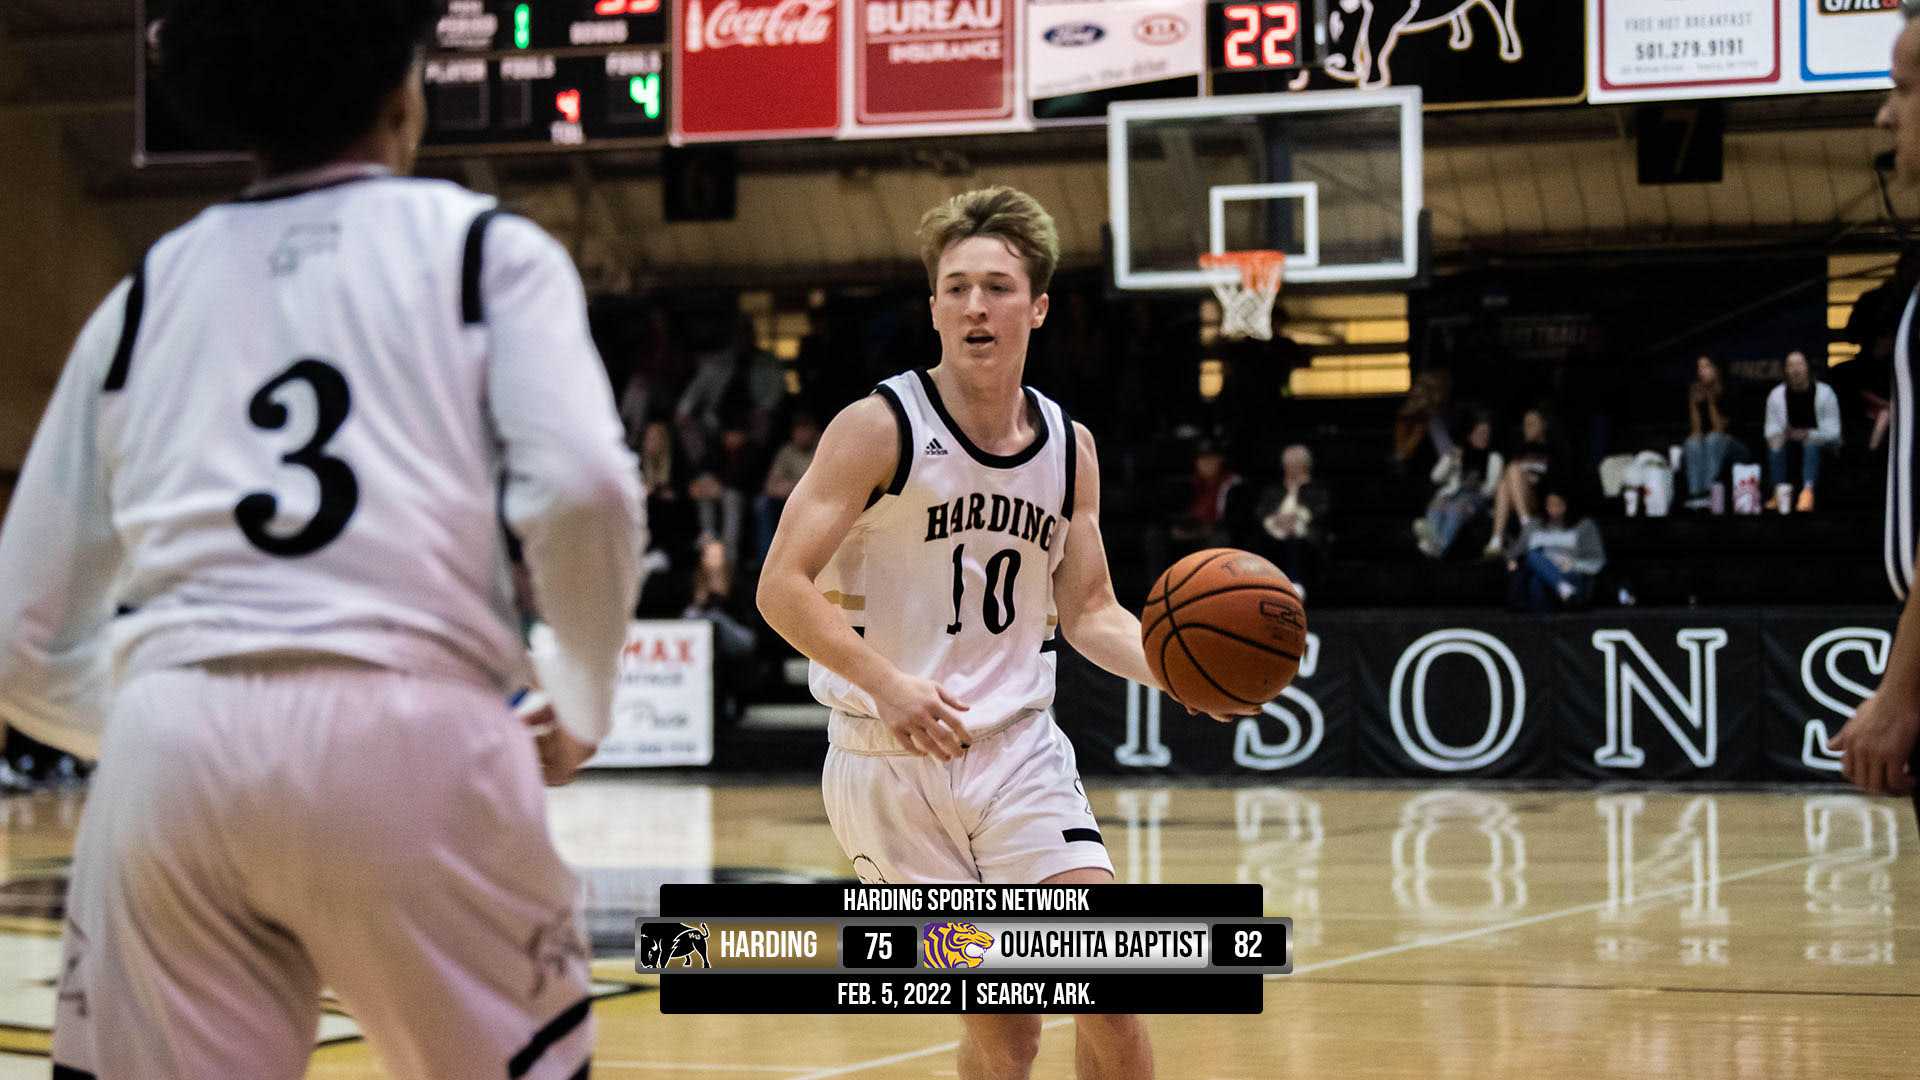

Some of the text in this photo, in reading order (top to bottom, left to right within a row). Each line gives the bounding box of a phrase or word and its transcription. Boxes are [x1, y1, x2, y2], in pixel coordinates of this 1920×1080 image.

[866, 0, 1000, 33] BUREAU
[1224, 3, 1299, 68] 22
[1624, 12, 1752, 32] FREE HOT BREAKFAST
[889, 39, 1000, 63] INSURANCE
[1635, 38, 1744, 61] 501.279.9191
[629, 73, 660, 119] 4
[234, 359, 358, 559] 3
[924, 492, 1057, 552] HARDING
[946, 543, 1022, 635] 10
